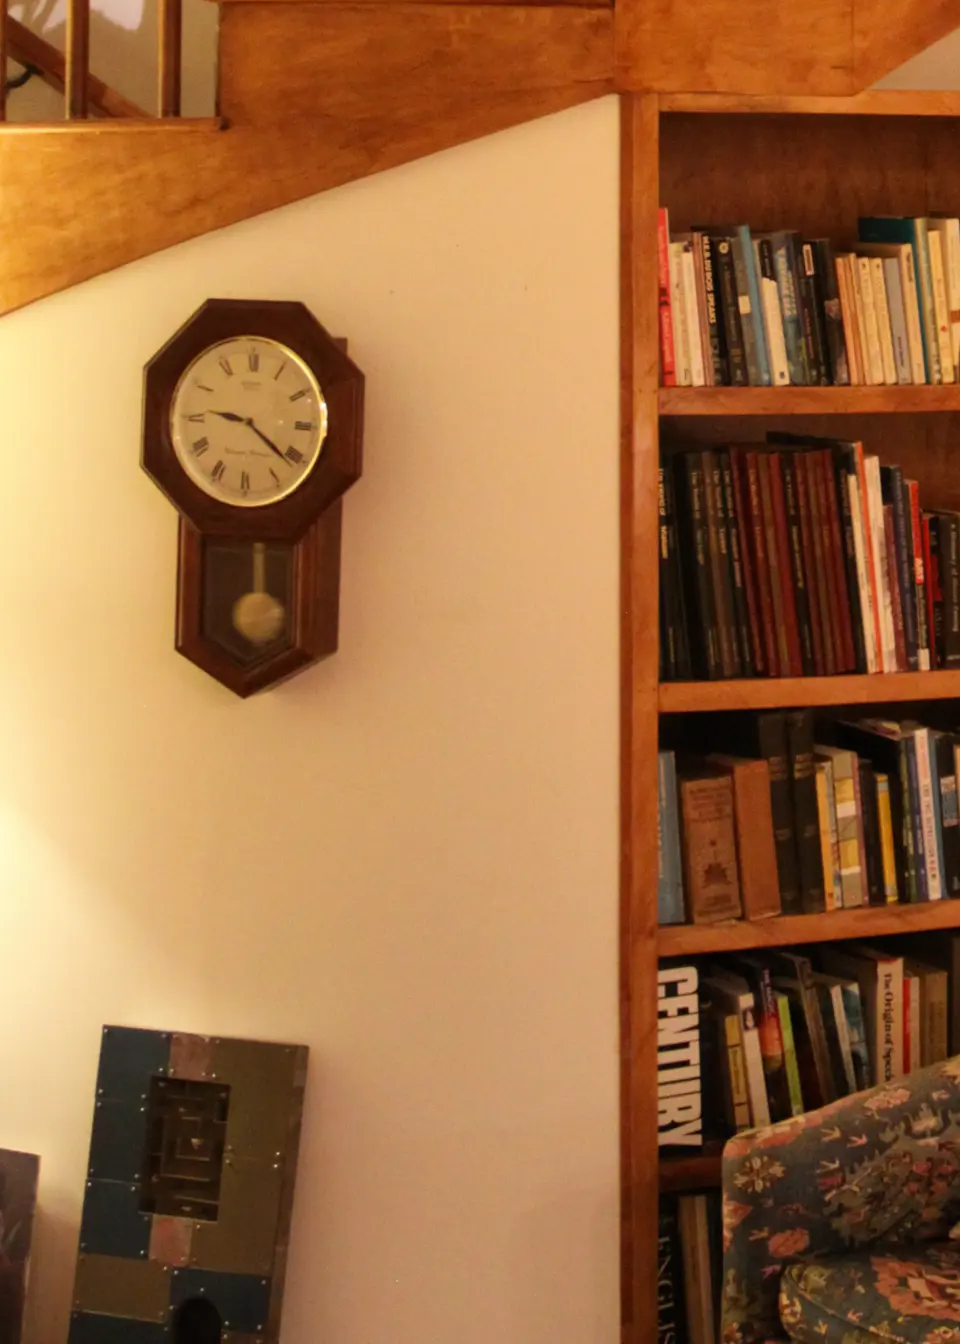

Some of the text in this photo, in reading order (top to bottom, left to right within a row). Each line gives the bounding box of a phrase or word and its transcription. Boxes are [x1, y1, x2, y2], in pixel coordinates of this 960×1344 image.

[882, 992, 893, 1031] Origin
[657, 966, 702, 1146] CENTURY
[884, 1033, 893, 1044] of
